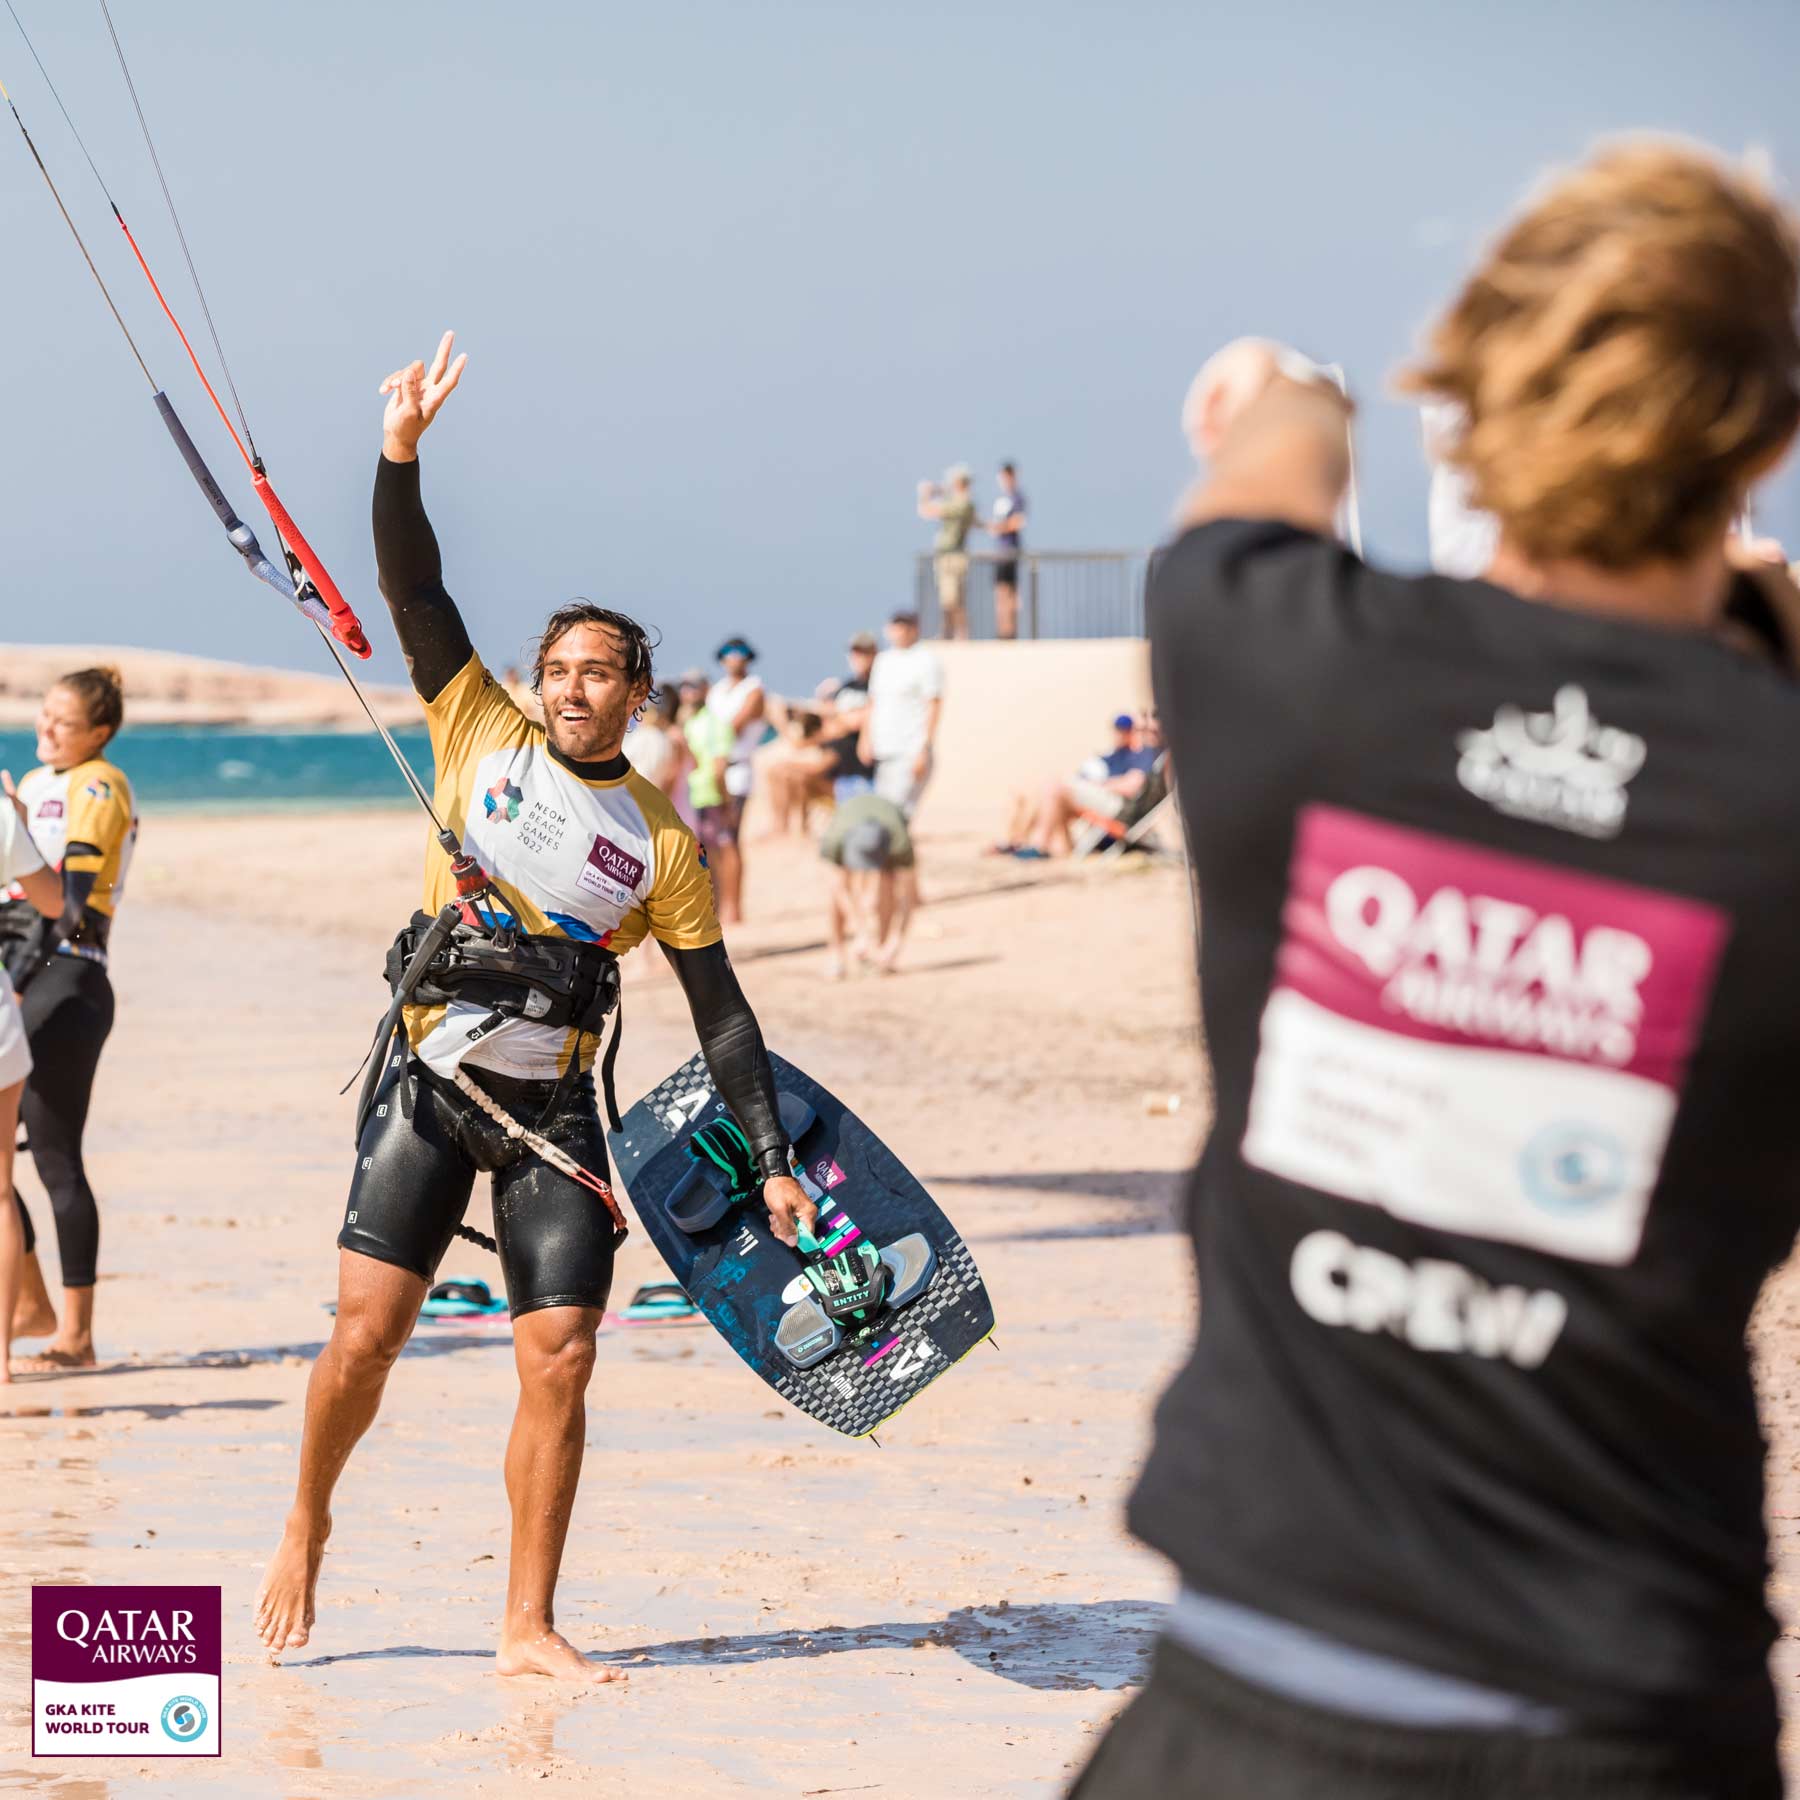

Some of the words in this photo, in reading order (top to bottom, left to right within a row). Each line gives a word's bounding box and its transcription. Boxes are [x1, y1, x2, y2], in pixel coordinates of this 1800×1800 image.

[528, 811, 564, 839] BEACH
[534, 801, 566, 825] NEOM
[517, 831, 543, 854] 2022
[522, 821, 560, 851] GAMES
[598, 845, 638, 878] QATAR
[604, 863, 633, 885] AIRWAYS
[832, 1290, 870, 1308] ENTITY
[829, 1370, 858, 1400] Jaime
